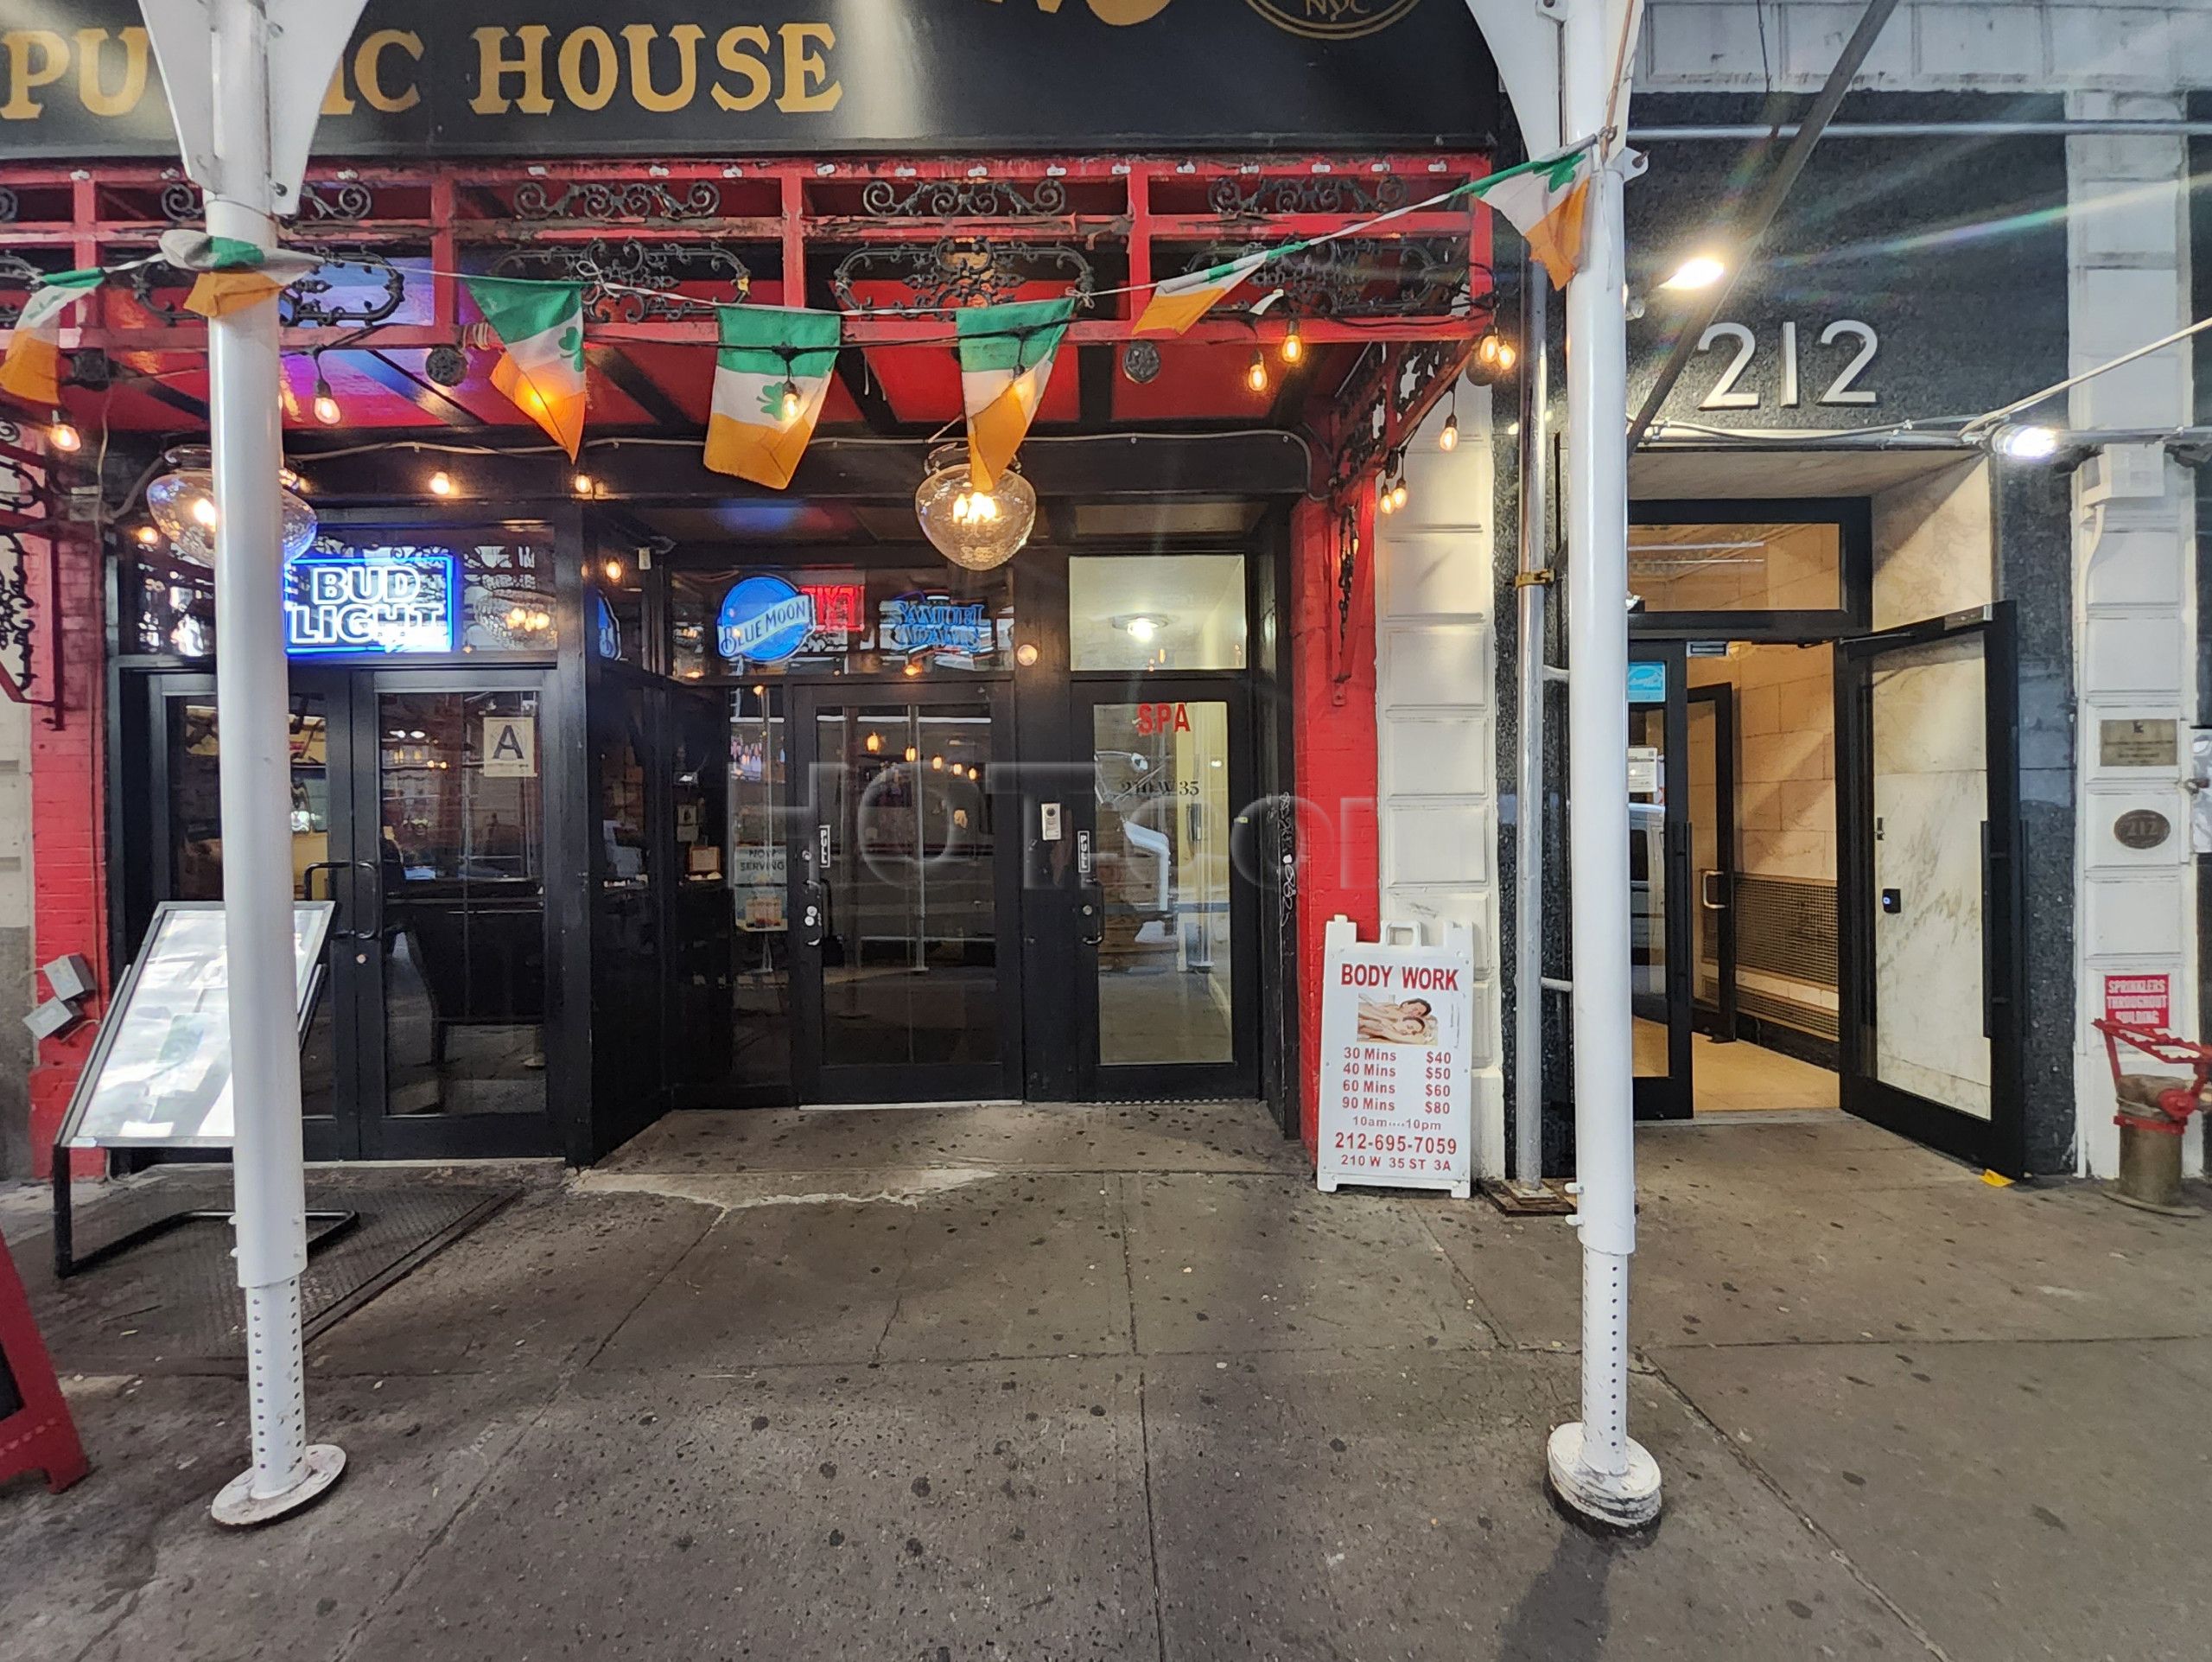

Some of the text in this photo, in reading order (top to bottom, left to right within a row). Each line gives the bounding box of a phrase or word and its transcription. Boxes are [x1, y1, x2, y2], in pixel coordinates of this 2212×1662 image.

[0, 22, 842, 119] PUC HOUSE
[1697, 320, 1878, 411] 212
[310, 566, 422, 606] BUD
[286, 604, 445, 645] LIGHT
[721, 620, 762, 655] BLUE
[766, 601, 806, 633] MOON
[1136, 703, 1191, 735] SPA
[492, 724, 524, 759] A
[1179, 780, 1199, 795] 35
[1080, 834, 1089, 869] PULL
[1340, 963, 1459, 991] BODY WORK
[1343, 1062, 1451, 1079] 40 Mins $50
[1344, 1047, 1452, 1064] 30 Mins $40
[1343, 1079, 1451, 1097] 60 Mins $60
[1342, 1096, 1451, 1114] 90 Mins $80
[1335, 1132, 1457, 1155] 212-695-7059
[1341, 1155, 1452, 1171] 210 W 35 ST 3A
